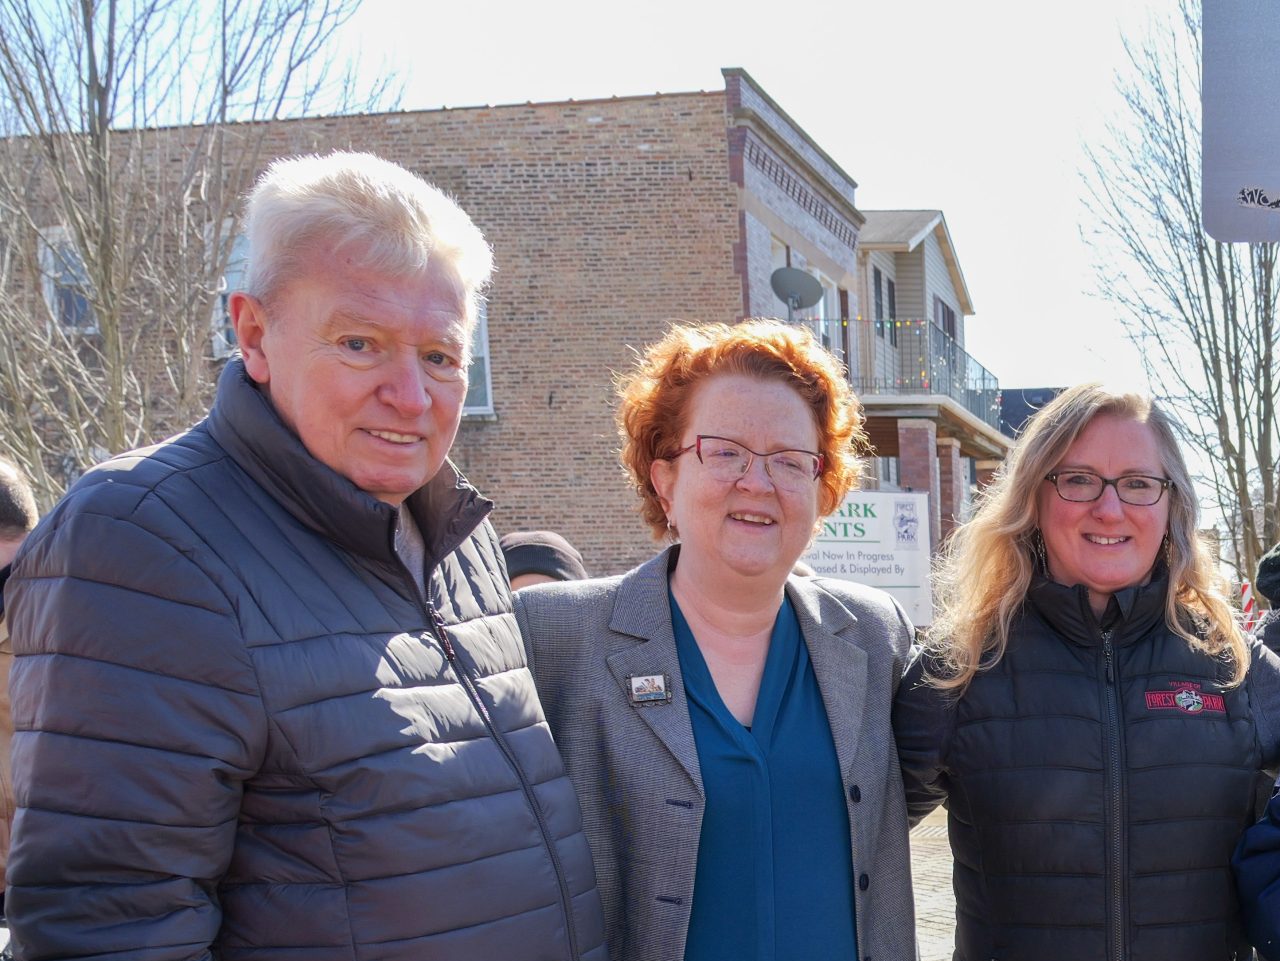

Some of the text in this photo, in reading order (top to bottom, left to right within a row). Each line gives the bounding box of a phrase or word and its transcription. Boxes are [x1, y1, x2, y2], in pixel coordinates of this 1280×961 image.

[823, 522, 865, 537] NTS
[822, 551, 844, 561] Now
[846, 551, 855, 560] In
[857, 551, 895, 563] Progress
[840, 564, 847, 574] &
[849, 564, 892, 576] Displayed
[894, 565, 905, 576] By
[1148, 694, 1222, 709] FOREST PARK
